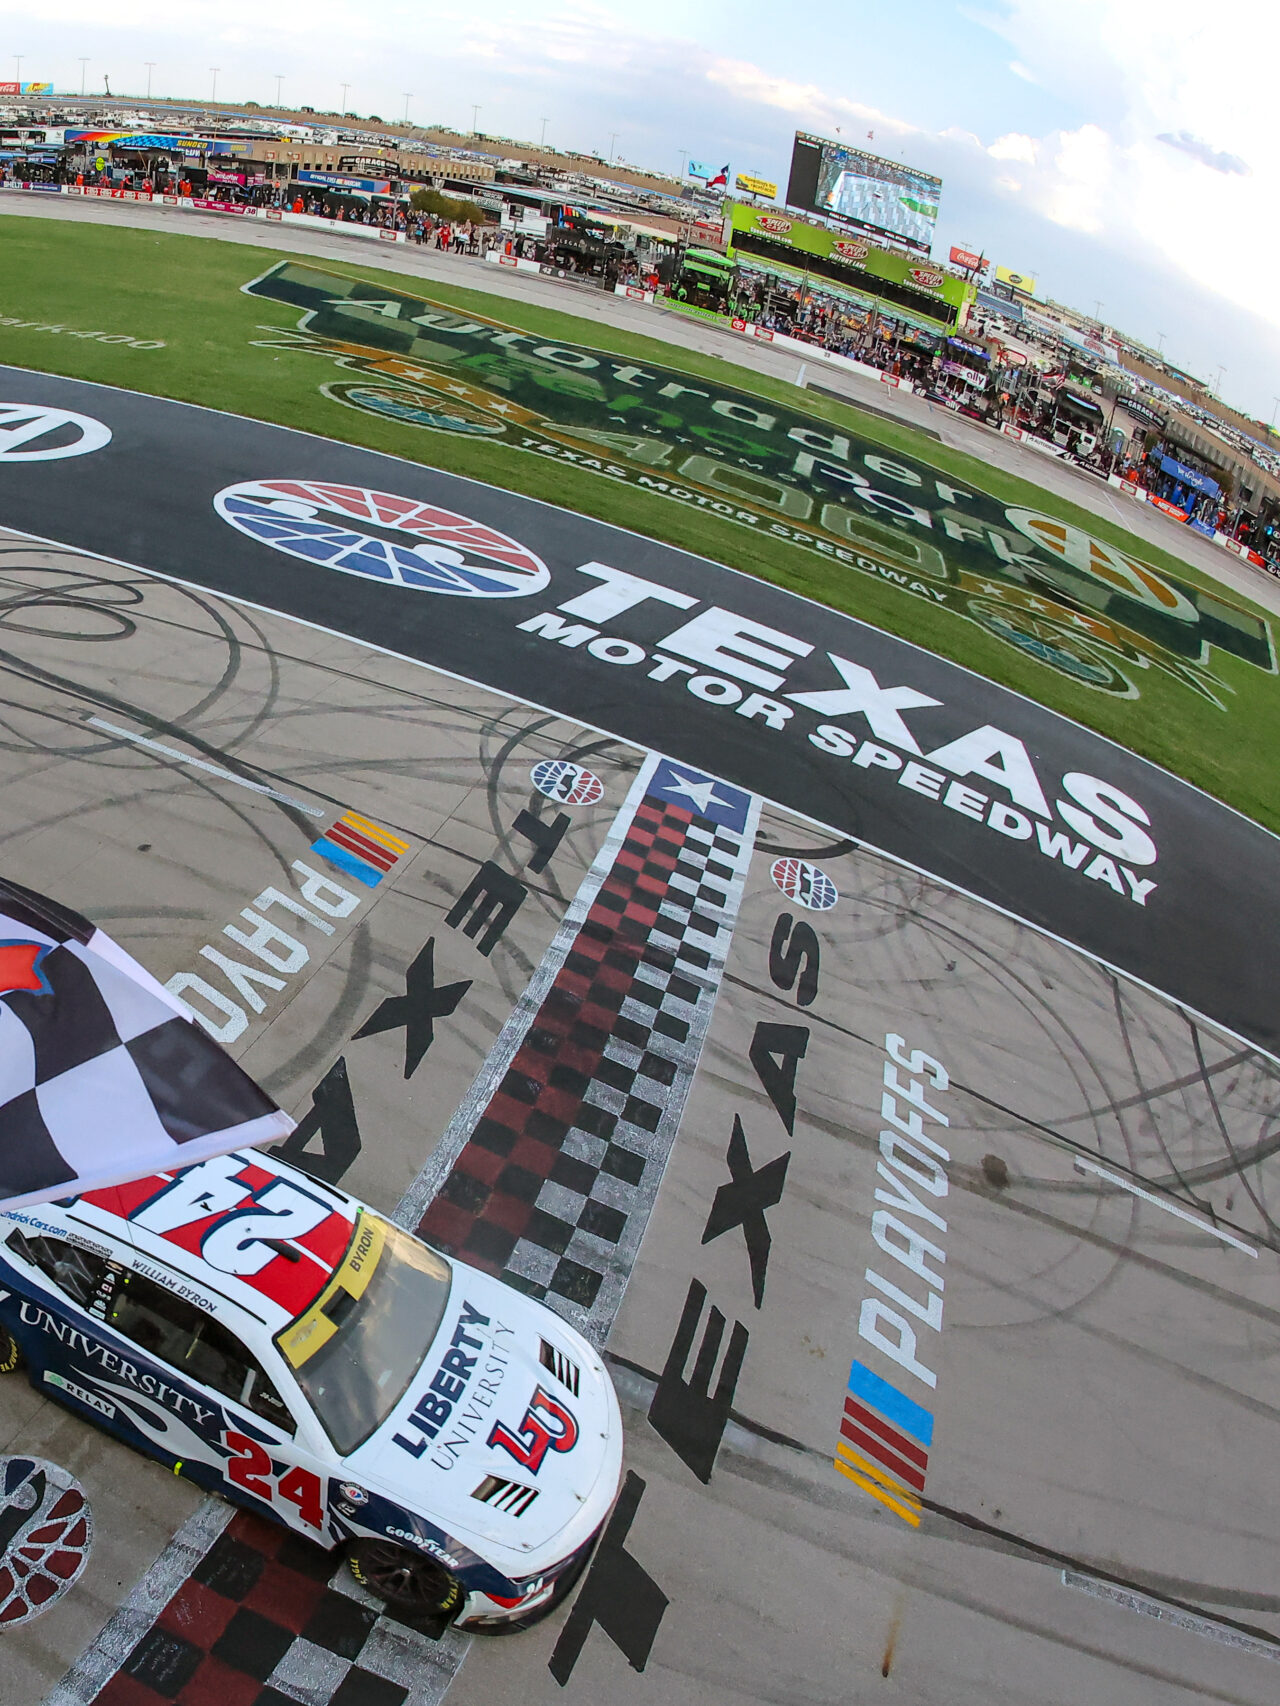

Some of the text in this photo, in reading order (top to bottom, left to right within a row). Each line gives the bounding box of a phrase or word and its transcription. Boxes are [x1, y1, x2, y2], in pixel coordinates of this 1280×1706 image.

[176, 139, 209, 149] SUNOCO
[355, 157, 386, 168] GARAGE
[804, 134, 836, 148] TEXAS
[839, 145, 876, 161] MOTOR
[878, 158, 932, 180] SPEEDWAY
[246, 206, 257, 215] 38
[766, 223, 789, 234] CASH
[767, 217, 791, 230] SPEEDY
[542, 266, 552, 275] 42
[841, 247, 864, 259] CASH
[842, 241, 867, 254] SPEEDY
[917, 276, 940, 288] CASH
[919, 270, 943, 282] SPEEDY
[966, 370, 986, 387] ally
[319, 298, 974, 506] Autotrader
[945, 399, 961, 412] ally
[1127, 400, 1155, 419] GARAGE
[1034, 437, 1059, 453] AUTODESK
[1085, 462, 1108, 479] AUTODESK
[520, 436, 948, 603] TEXAS MOTOR SPEEDWAY
[557, 561, 1158, 867] TEXAS
[516, 612, 1158, 907] MOTOR SPEEDWAY
[161, 859, 362, 1043] PLAYO
[268, 807, 572, 1187] TEXA
[858, 1032, 951, 1389] PLAYOFFS
[348, 1227, 376, 1273] BYRON
[131, 1258, 219, 1314] WILLIAM BYRON
[547, 912, 821, 1688] TEXAS
[19, 1299, 216, 1427] UNIVERSITY
[391, 1299, 492, 1460] LIBERTY
[65, 1383, 115, 1416] RELAY
[430, 1319, 516, 1472] UNIVERSITY
[223, 1429, 327, 1531] 24
[385, 1524, 460, 1570] GOODYEAR
